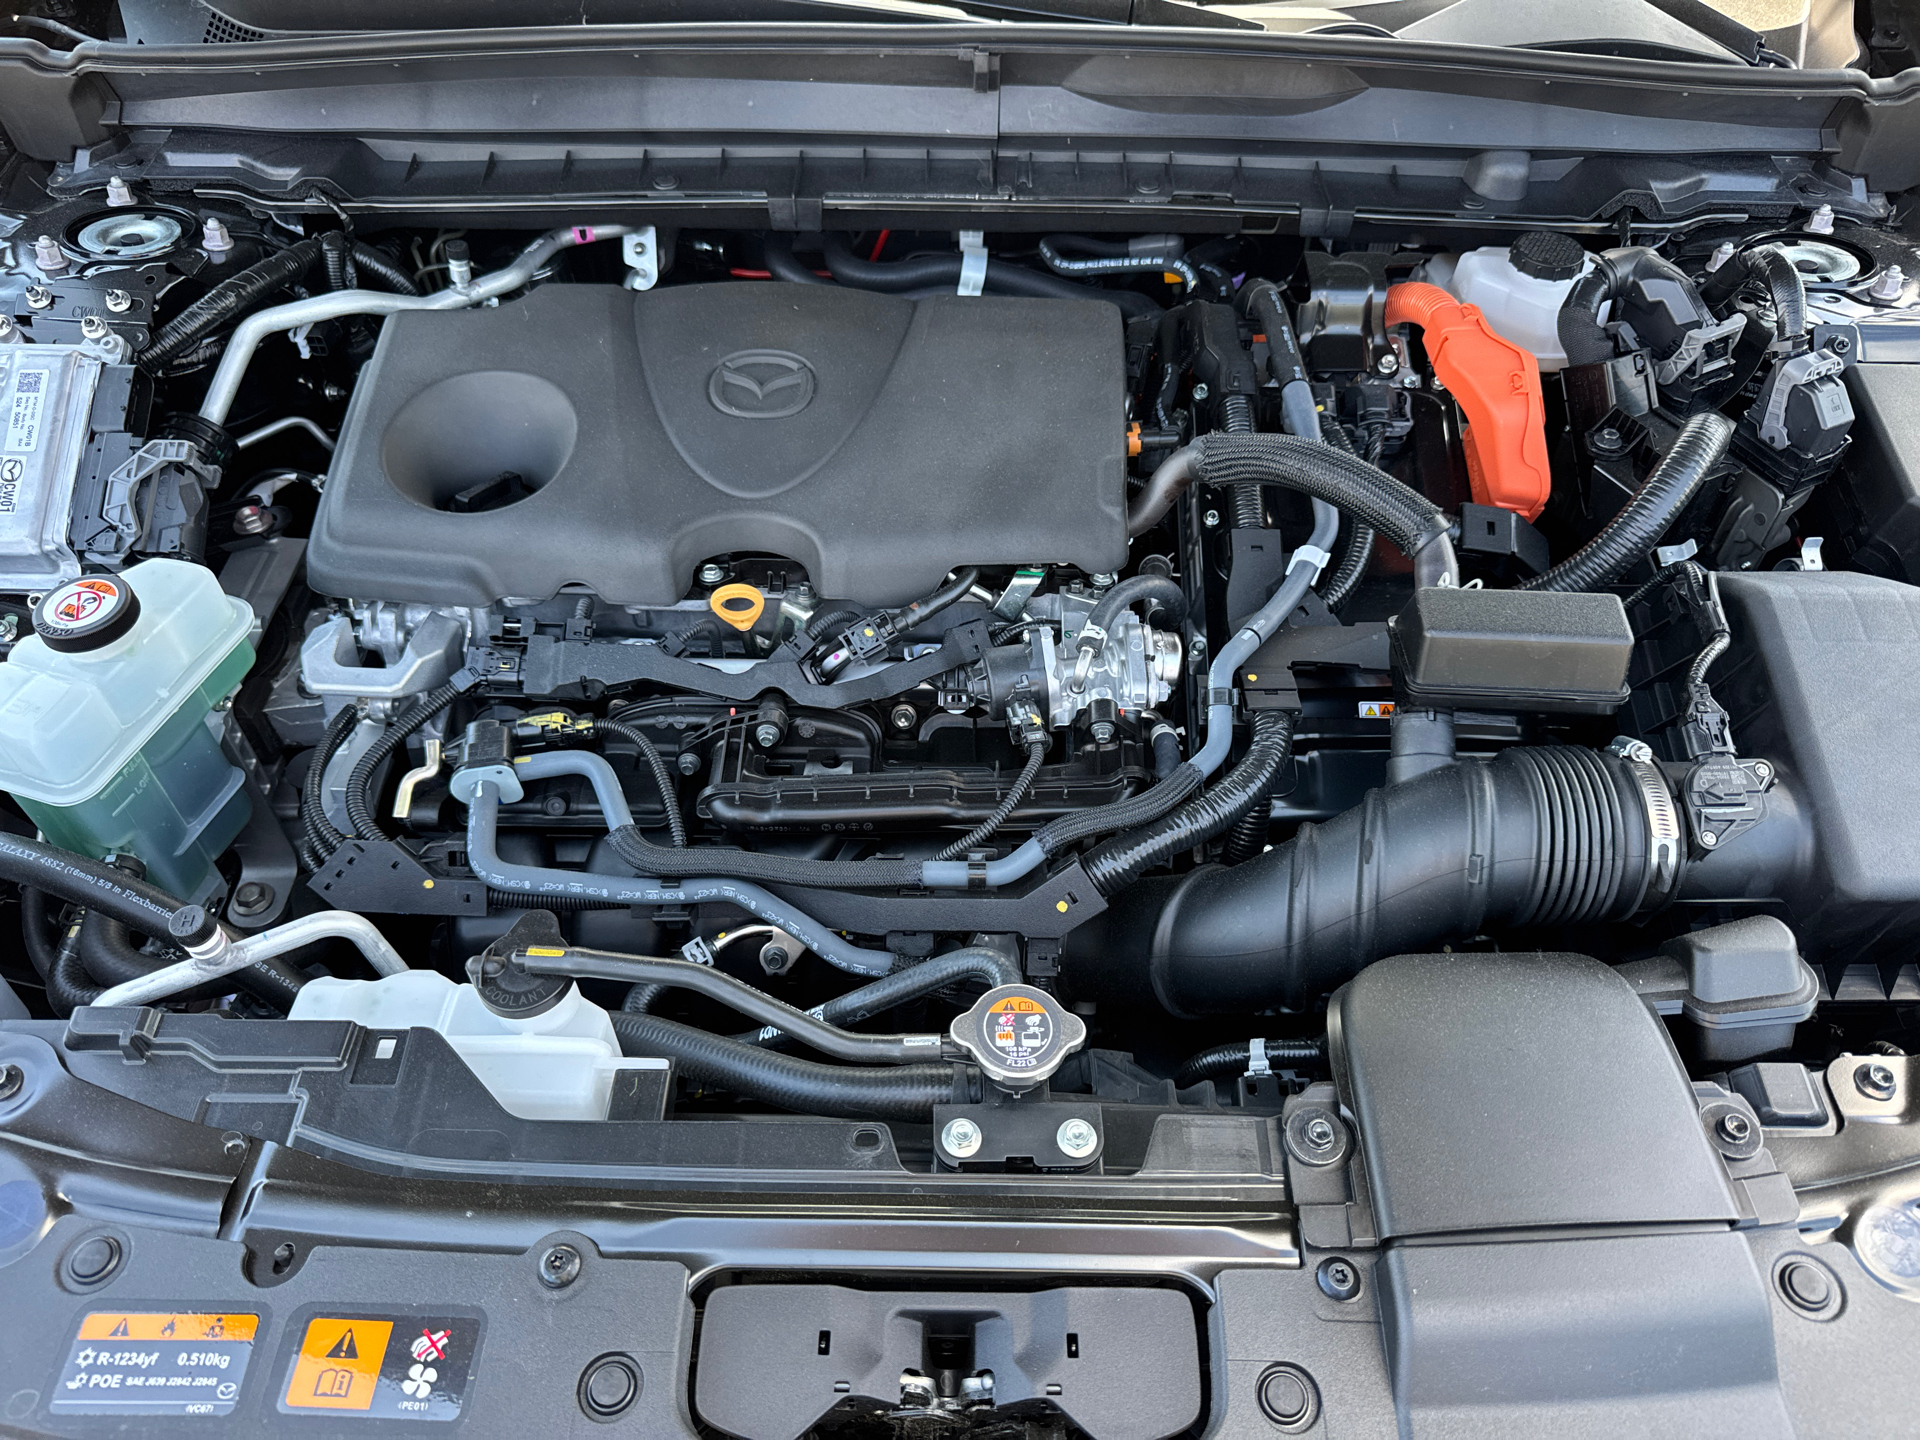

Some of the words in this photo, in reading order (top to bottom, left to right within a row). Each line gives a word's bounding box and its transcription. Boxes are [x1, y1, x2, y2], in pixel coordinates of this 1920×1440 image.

[0, 483, 16, 512] CW01
[35, 622, 74, 636] DENSO
[64, 865, 97, 885] (16mm)
[97, 878, 112, 890] 5/8
[181, 914, 195, 927] H
[268, 969, 299, 993] R-134a
[485, 986, 547, 1006] COOLANT
[97, 1352, 160, 1369] R-1234yf
[177, 1352, 230, 1369] 0.510kg
[89, 1374, 123, 1388] POE
[125, 1377, 145, 1386] SAE
[397, 1401, 429, 1412] (PE01)
